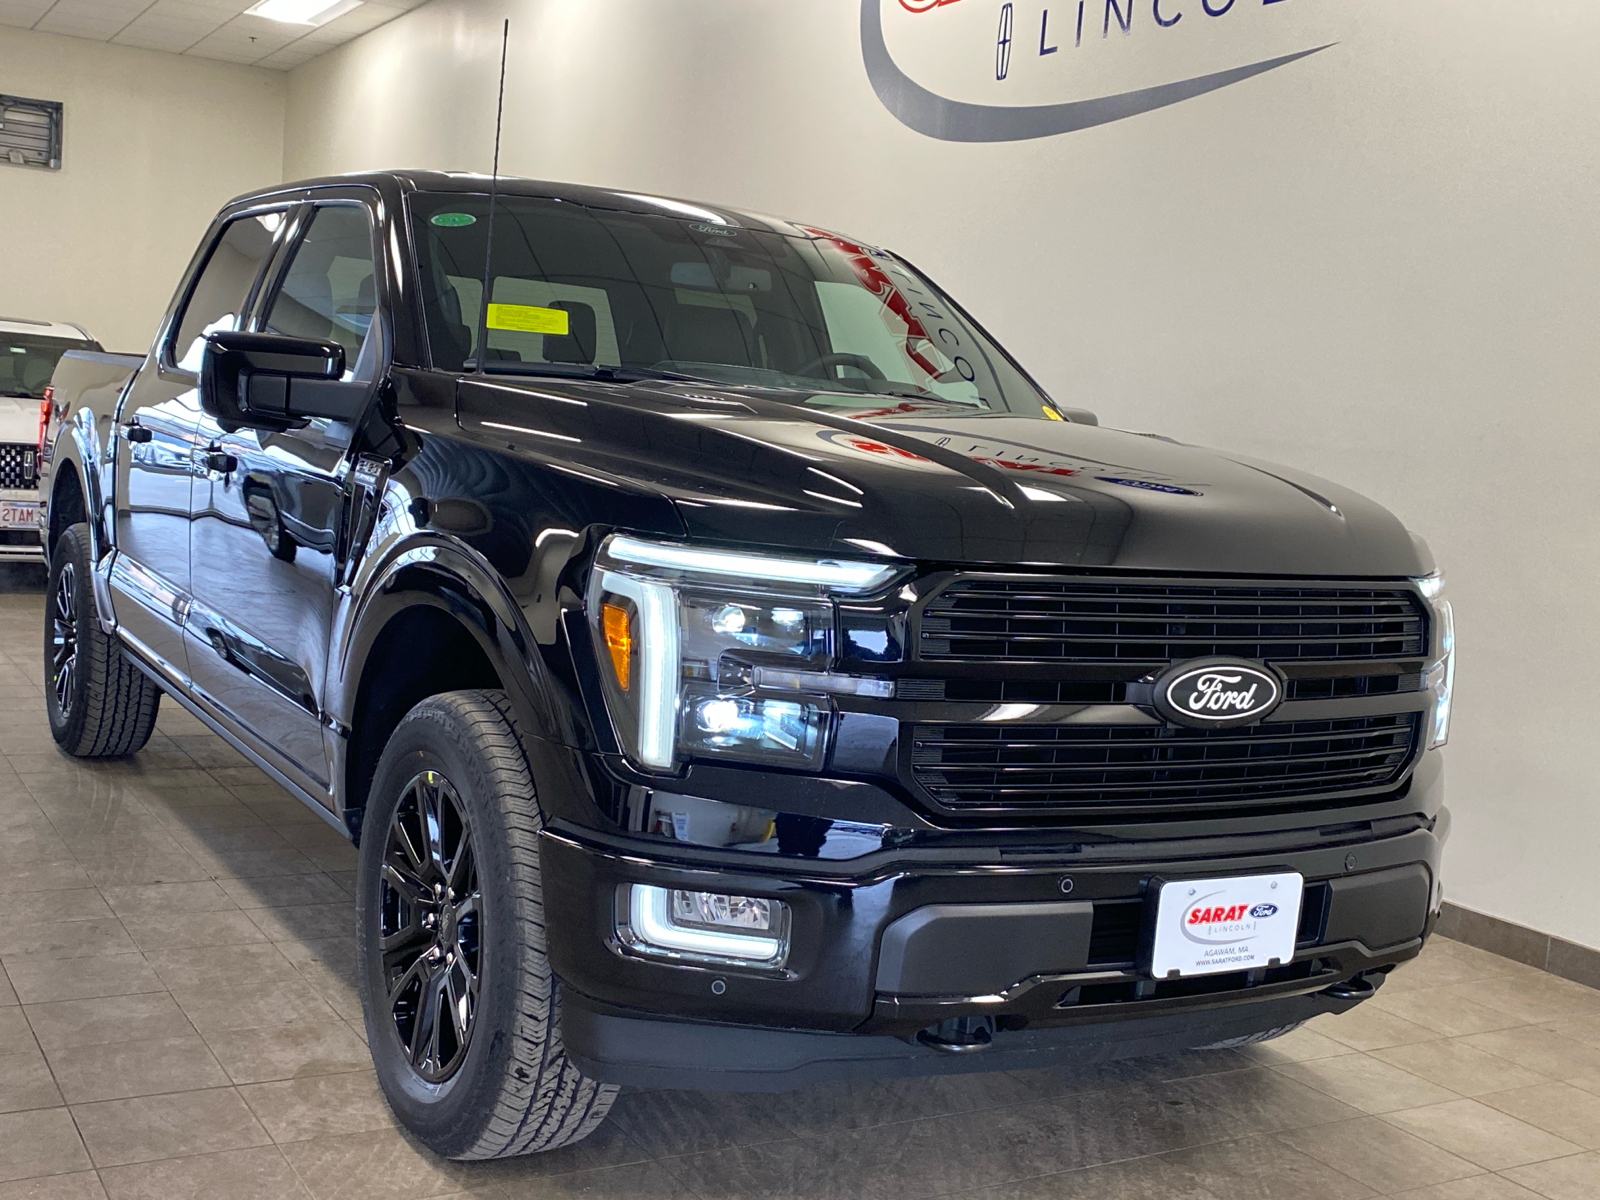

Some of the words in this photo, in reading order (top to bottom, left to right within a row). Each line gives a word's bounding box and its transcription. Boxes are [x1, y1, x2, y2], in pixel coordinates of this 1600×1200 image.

[2, 508, 34, 522] 2TAM
[1188, 673, 1258, 710] Ford
[1188, 904, 1249, 925] SARAT
[1254, 905, 1274, 917] Ford
[1215, 925, 1250, 933] LINCOLN
[1204, 948, 1236, 957] AGAWAM,
[1196, 955, 1254, 966] WWW.SARATFORD.COM
